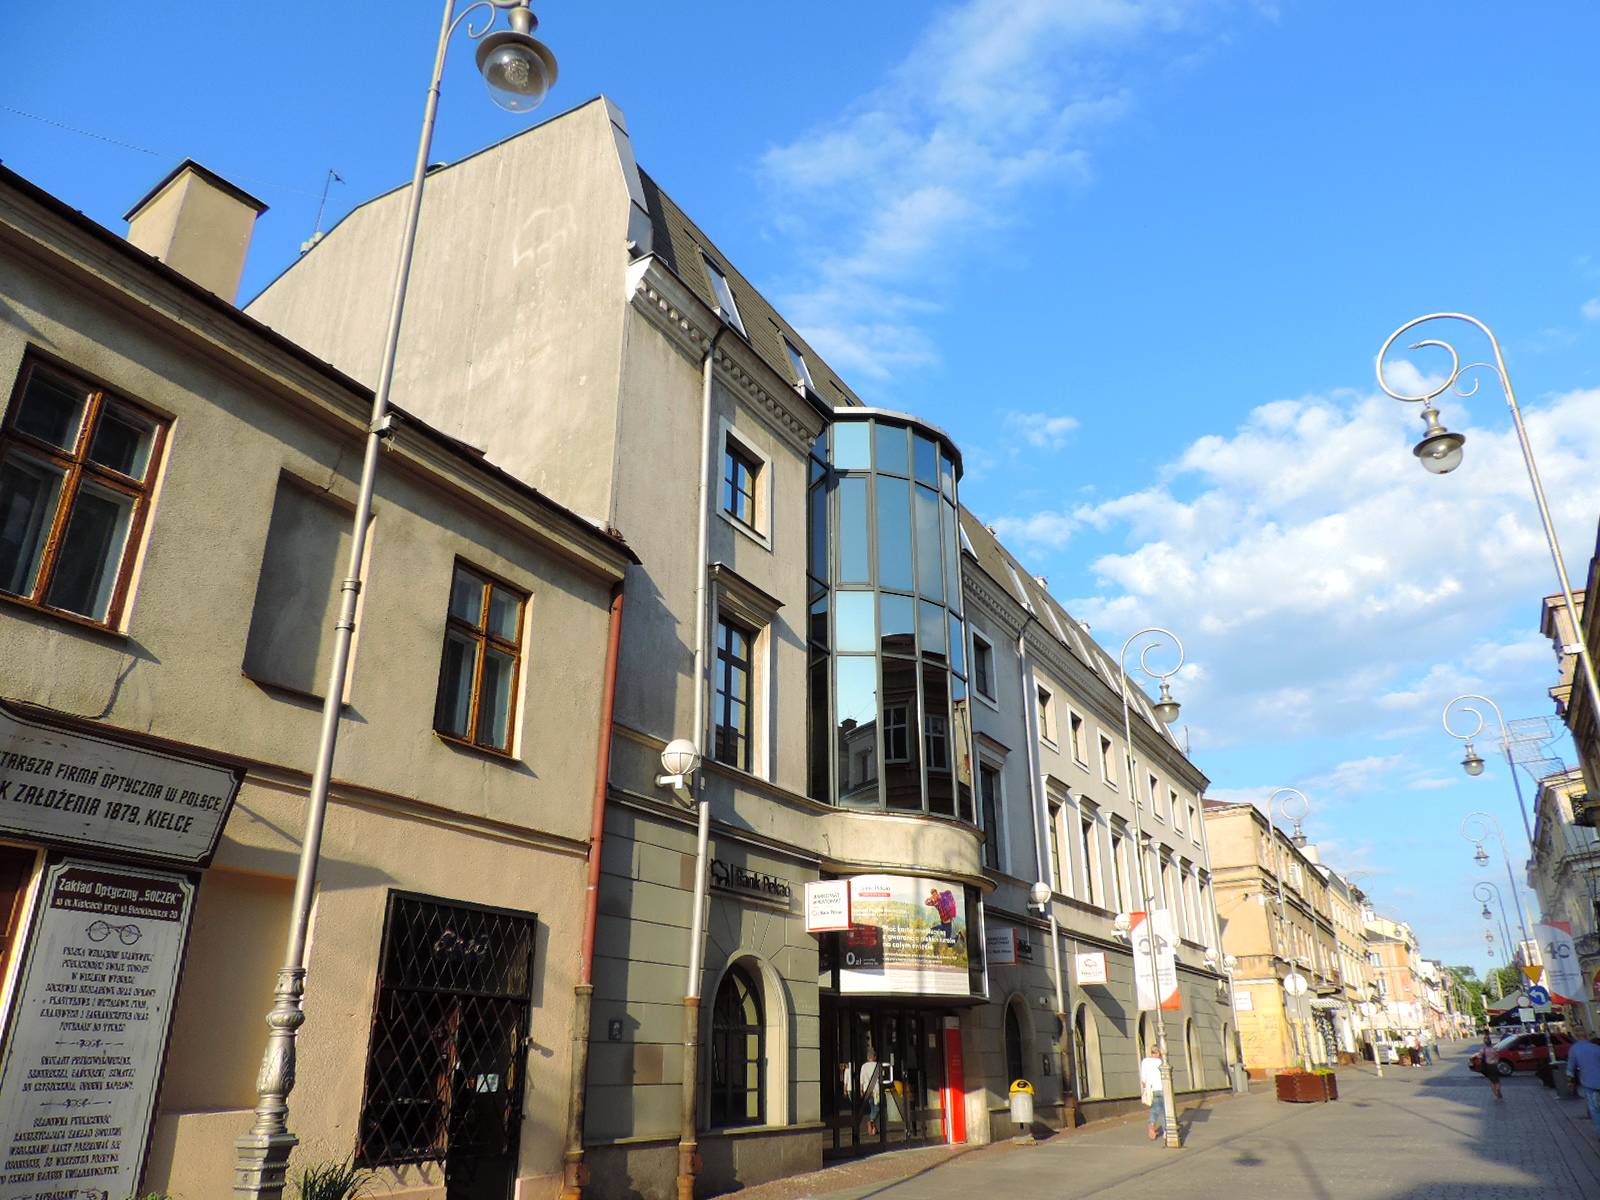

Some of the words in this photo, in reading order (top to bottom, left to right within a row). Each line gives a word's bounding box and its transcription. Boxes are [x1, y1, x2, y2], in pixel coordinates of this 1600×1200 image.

[13, 784, 102, 817] ZAŁOŻENIA
[104, 801, 140, 826] 1879,
[143, 809, 194, 833] KIELCE
[55, 763, 99, 786] FIRMA
[100, 773, 164, 799] OPTYCZNA
[165, 786, 178, 802] W
[180, 789, 222, 811] POLSCE
[58, 878, 92, 894] Zakład
[94, 883, 139, 901] Optyczny
